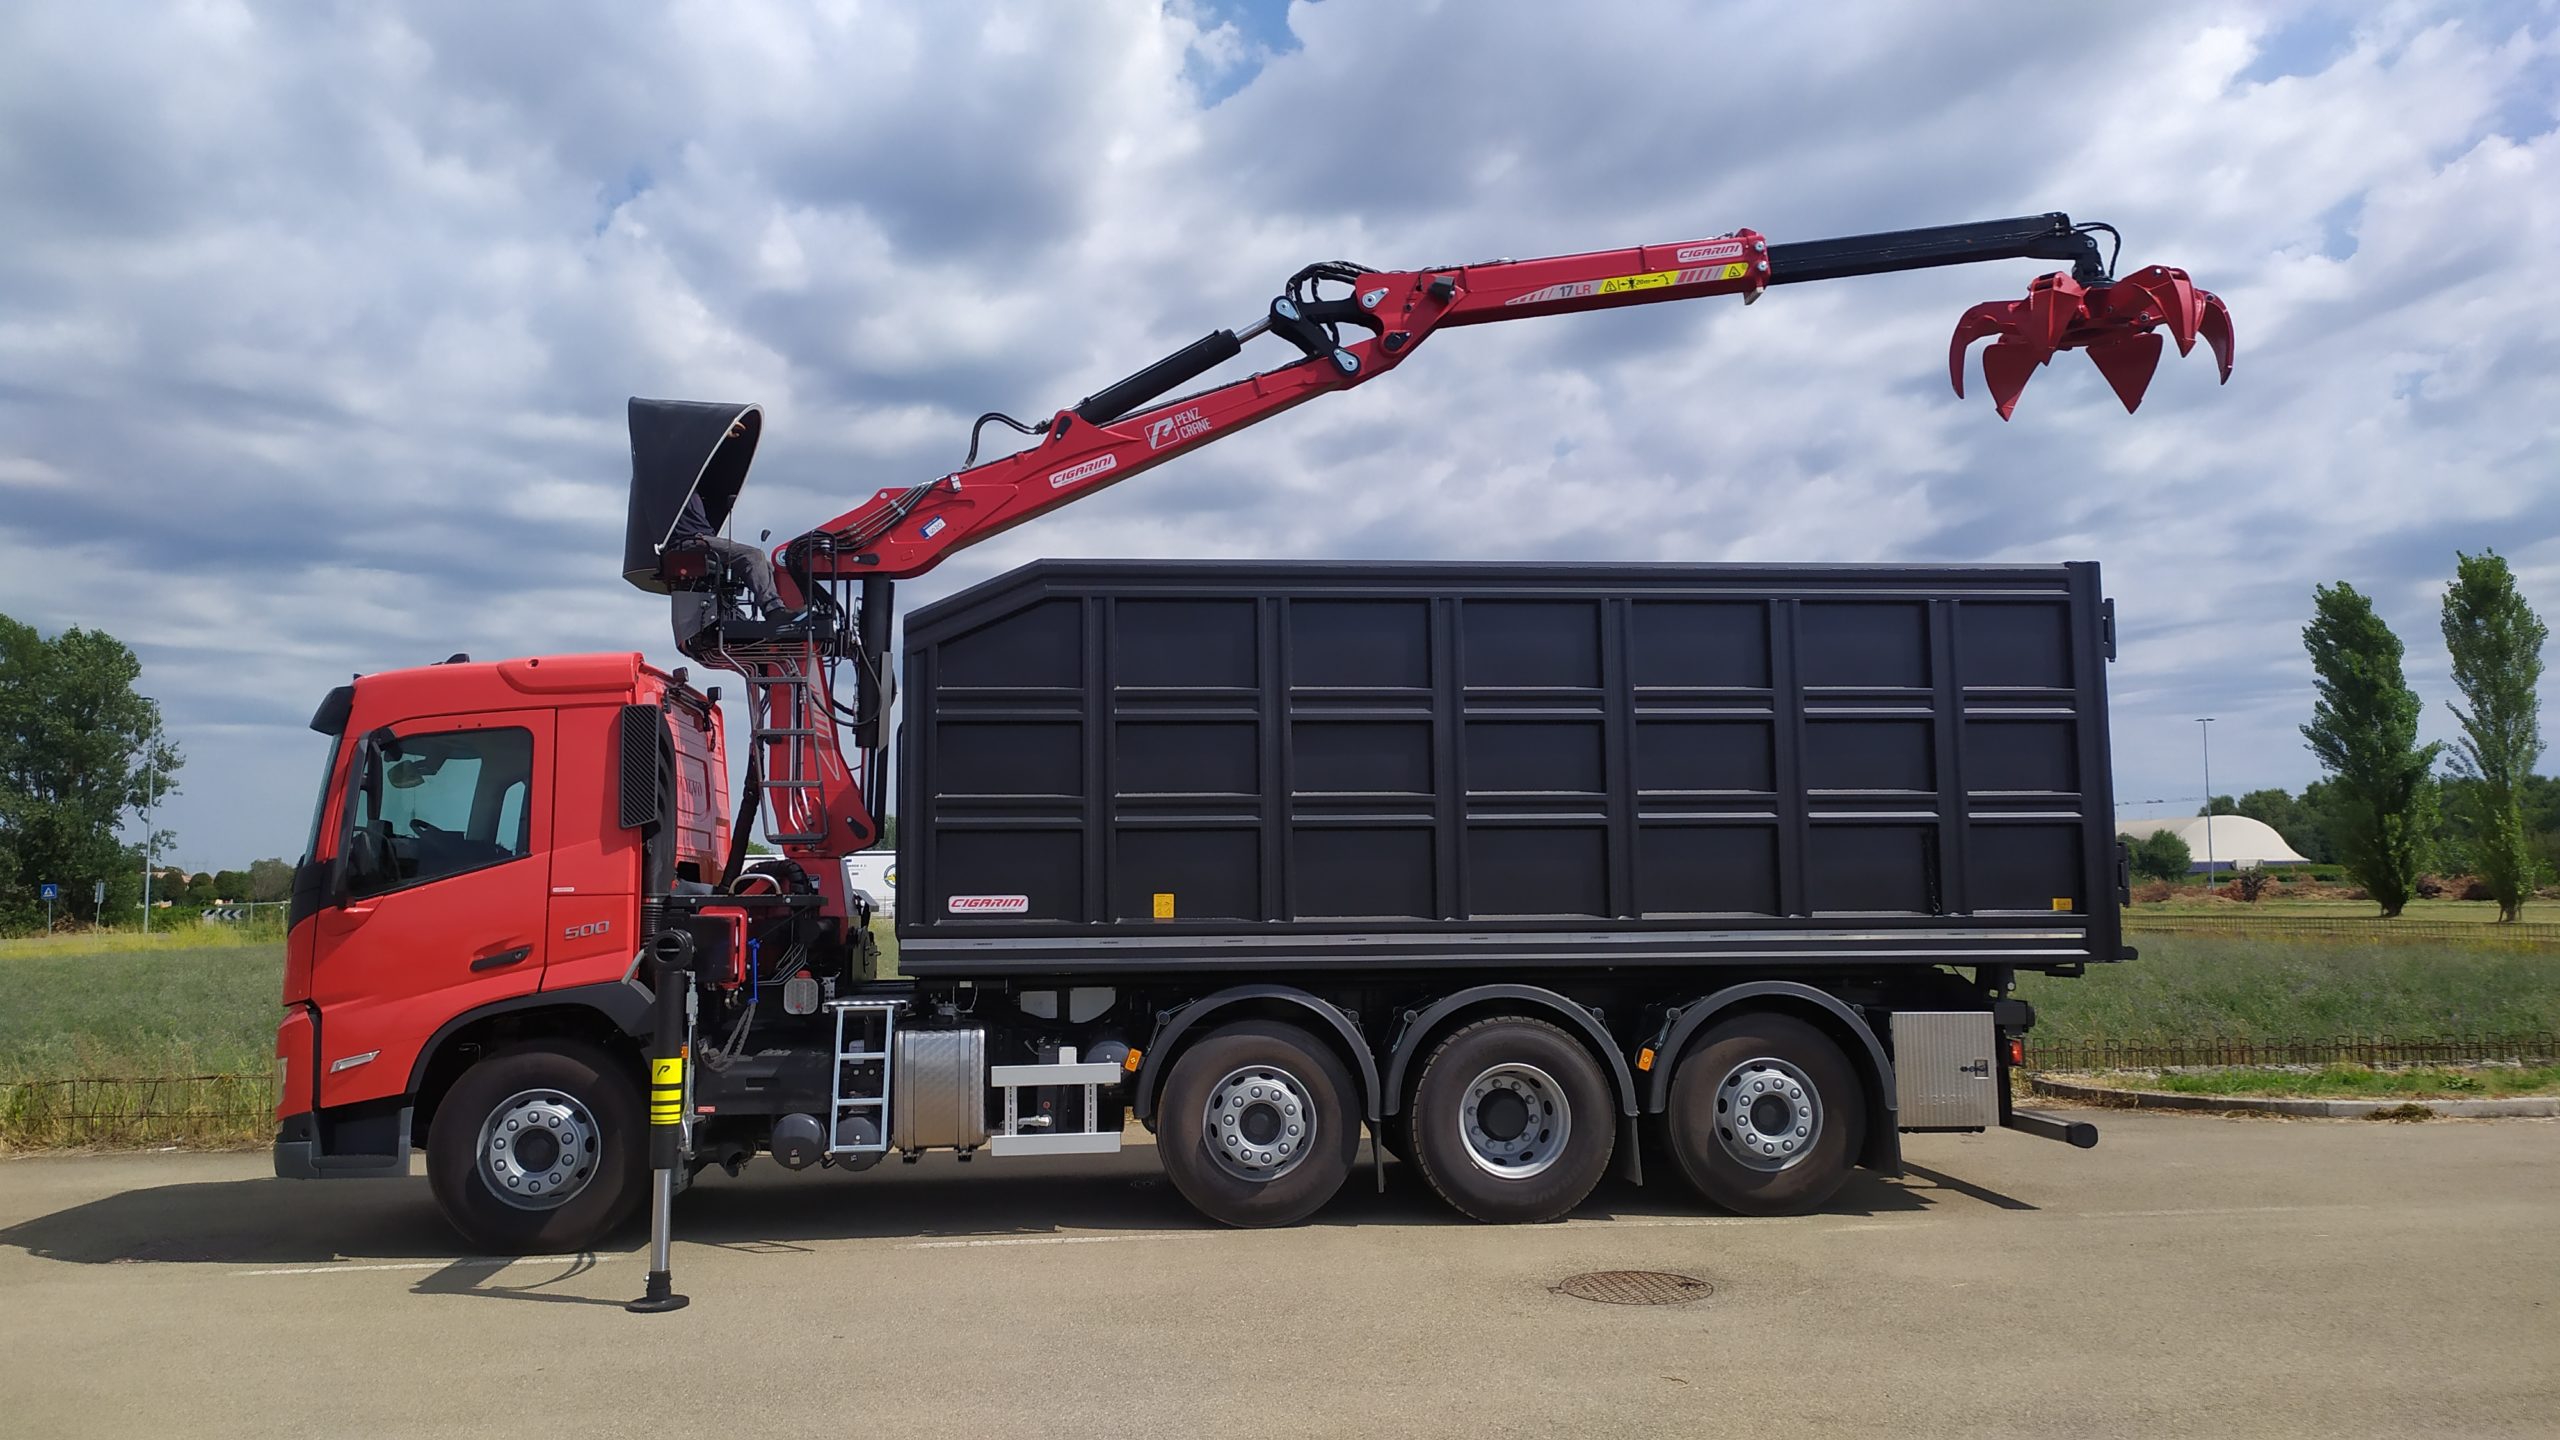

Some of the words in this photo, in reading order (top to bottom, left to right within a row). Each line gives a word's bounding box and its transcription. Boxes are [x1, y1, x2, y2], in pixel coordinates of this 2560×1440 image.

[1679, 244, 1740, 260] CIGARINI
[1559, 285, 1573, 298] 17
[1575, 284, 1591, 296] LR
[1174, 407, 1202, 427] PENZ
[1180, 417, 1213, 439] CRANE
[1052, 456, 1113, 485] CIGARINI
[951, 898, 1026, 909] CIGARINI
[565, 920, 610, 940] 500
